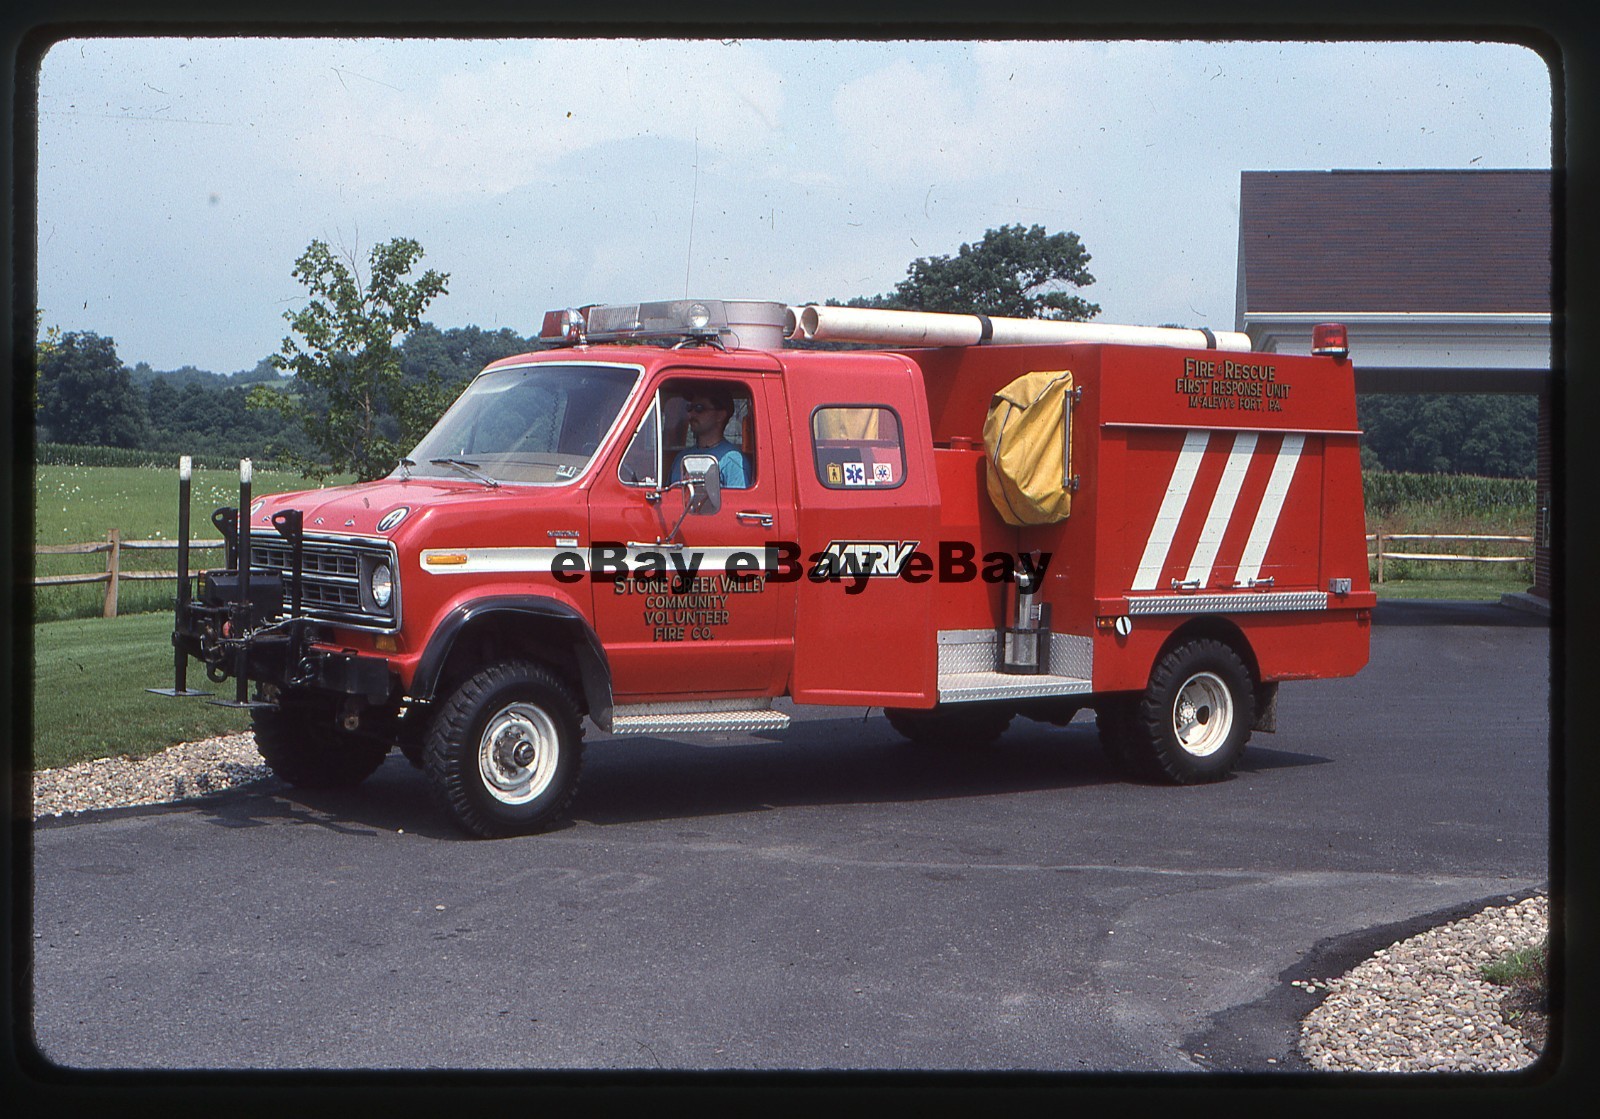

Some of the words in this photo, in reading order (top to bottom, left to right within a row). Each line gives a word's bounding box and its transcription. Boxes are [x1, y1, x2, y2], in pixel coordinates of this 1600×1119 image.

[1184, 357, 1215, 378] FIRE
[1224, 360, 1276, 382] RESCUE
[1176, 378, 1209, 395] FIRST
[1212, 380, 1264, 397] RESPONSE
[1266, 383, 1291, 399] UNIT
[815, 543, 915, 576] MERV
[614, 575, 669, 595] STONE
[672, 574, 719, 594] CREEK
[718, 573, 767, 593] VALLEY
[645, 594, 729, 609] COMMUNITY
[644, 610, 730, 626] VOLUNTEER
[653, 627, 685, 641] FIRE
[691, 626, 715, 640] CO.
